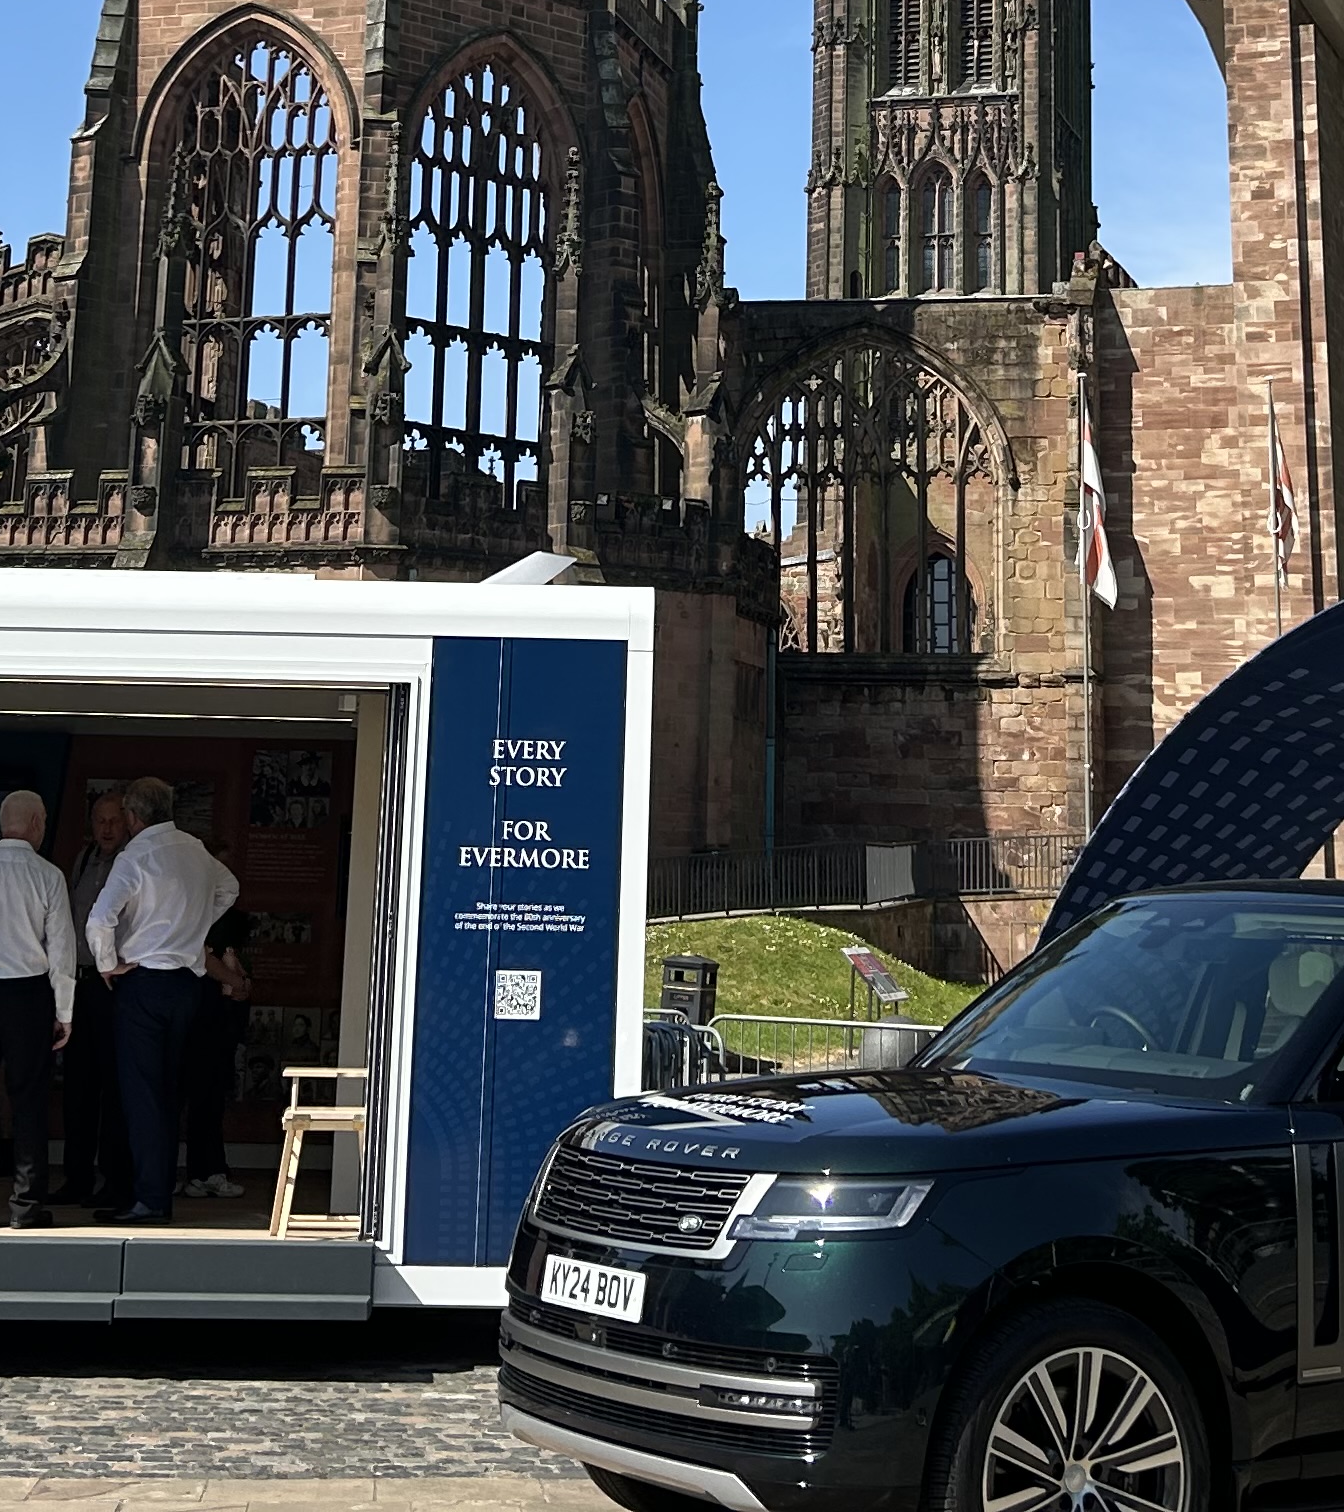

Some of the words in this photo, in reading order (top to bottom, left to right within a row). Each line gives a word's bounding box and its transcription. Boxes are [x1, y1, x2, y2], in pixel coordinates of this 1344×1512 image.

[493, 740, 566, 760] EVERY
[489, 766, 567, 786] STORY
[502, 821, 551, 841] FOR
[459, 846, 590, 869] EVERMORE
[476, 902, 497, 910] Share
[510, 913, 522, 921] the
[543, 915, 585, 923] anniversary
[517, 923, 543, 931] Second
[646, 1139, 742, 1160] ROVER
[550, 1261, 591, 1303] KY24
[595, 1272, 635, 1312] BOV
